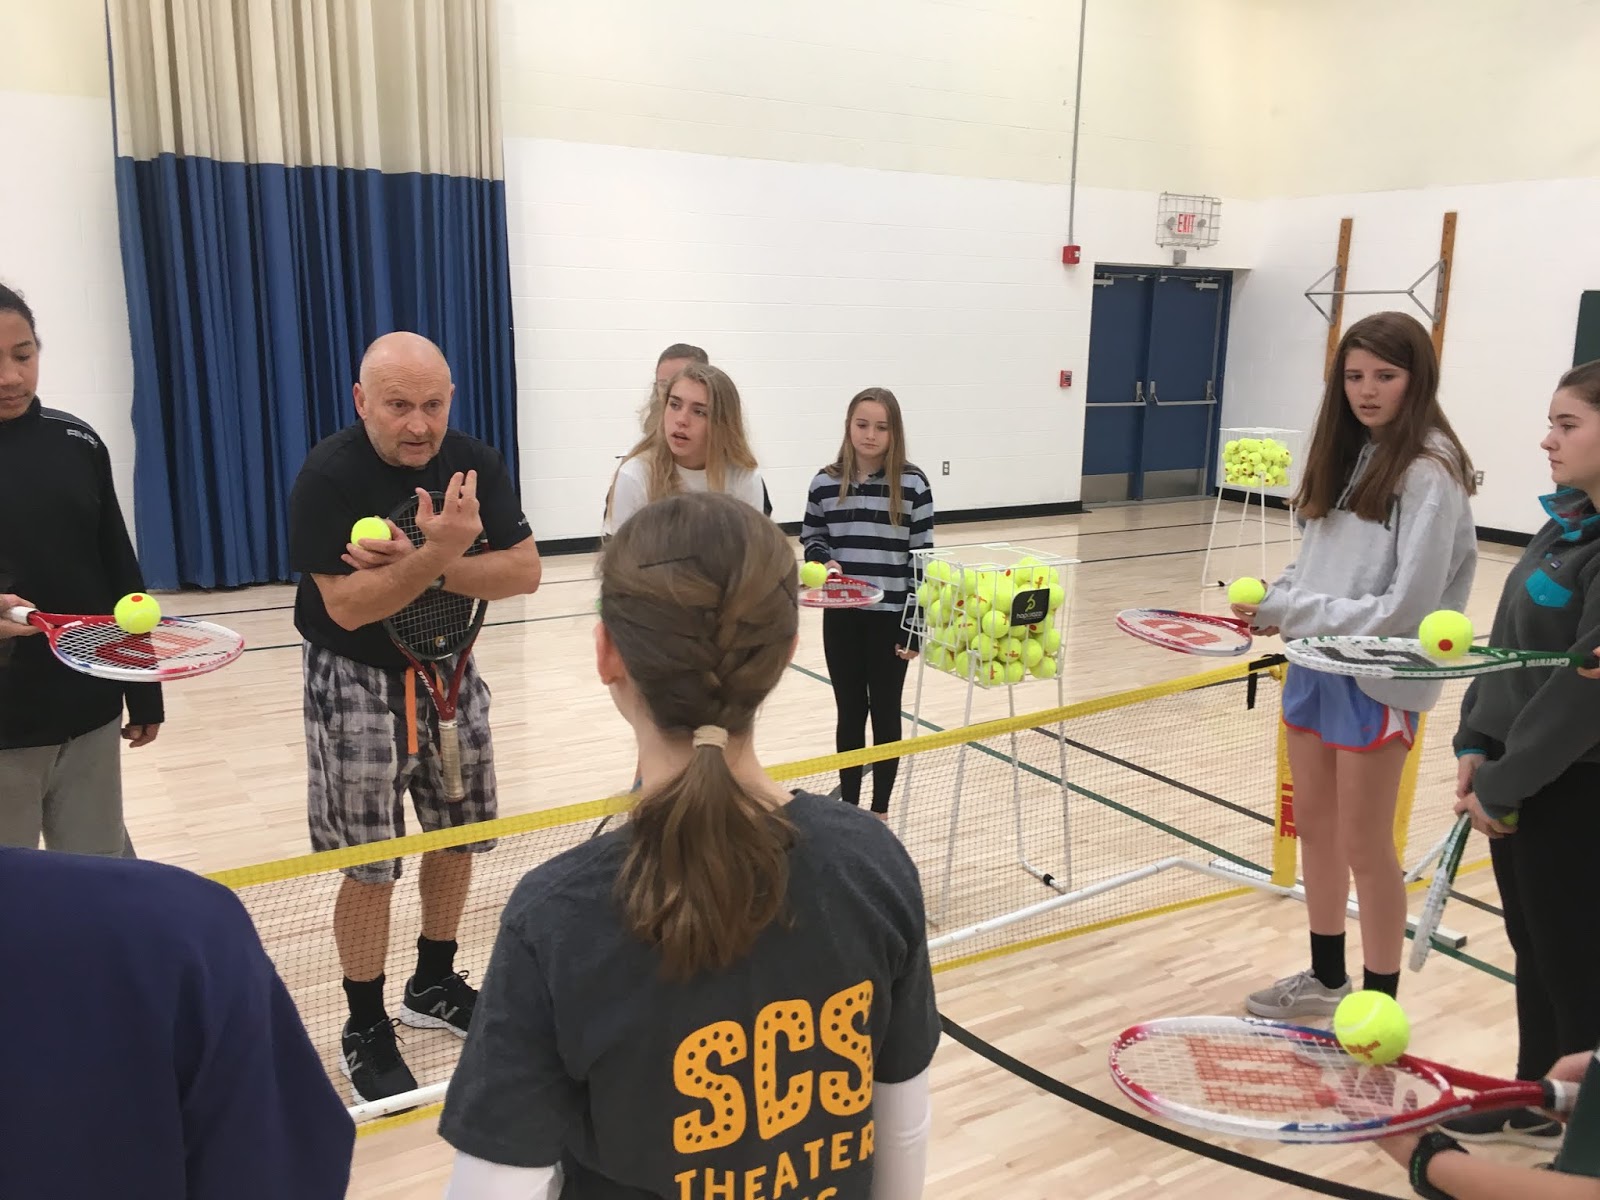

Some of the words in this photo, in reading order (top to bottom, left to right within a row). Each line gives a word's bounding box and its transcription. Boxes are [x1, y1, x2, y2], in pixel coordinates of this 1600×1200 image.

[1177, 213, 1196, 233] EXIT
[673, 979, 874, 1154] SCS
[674, 1120, 875, 1200] THEATER
